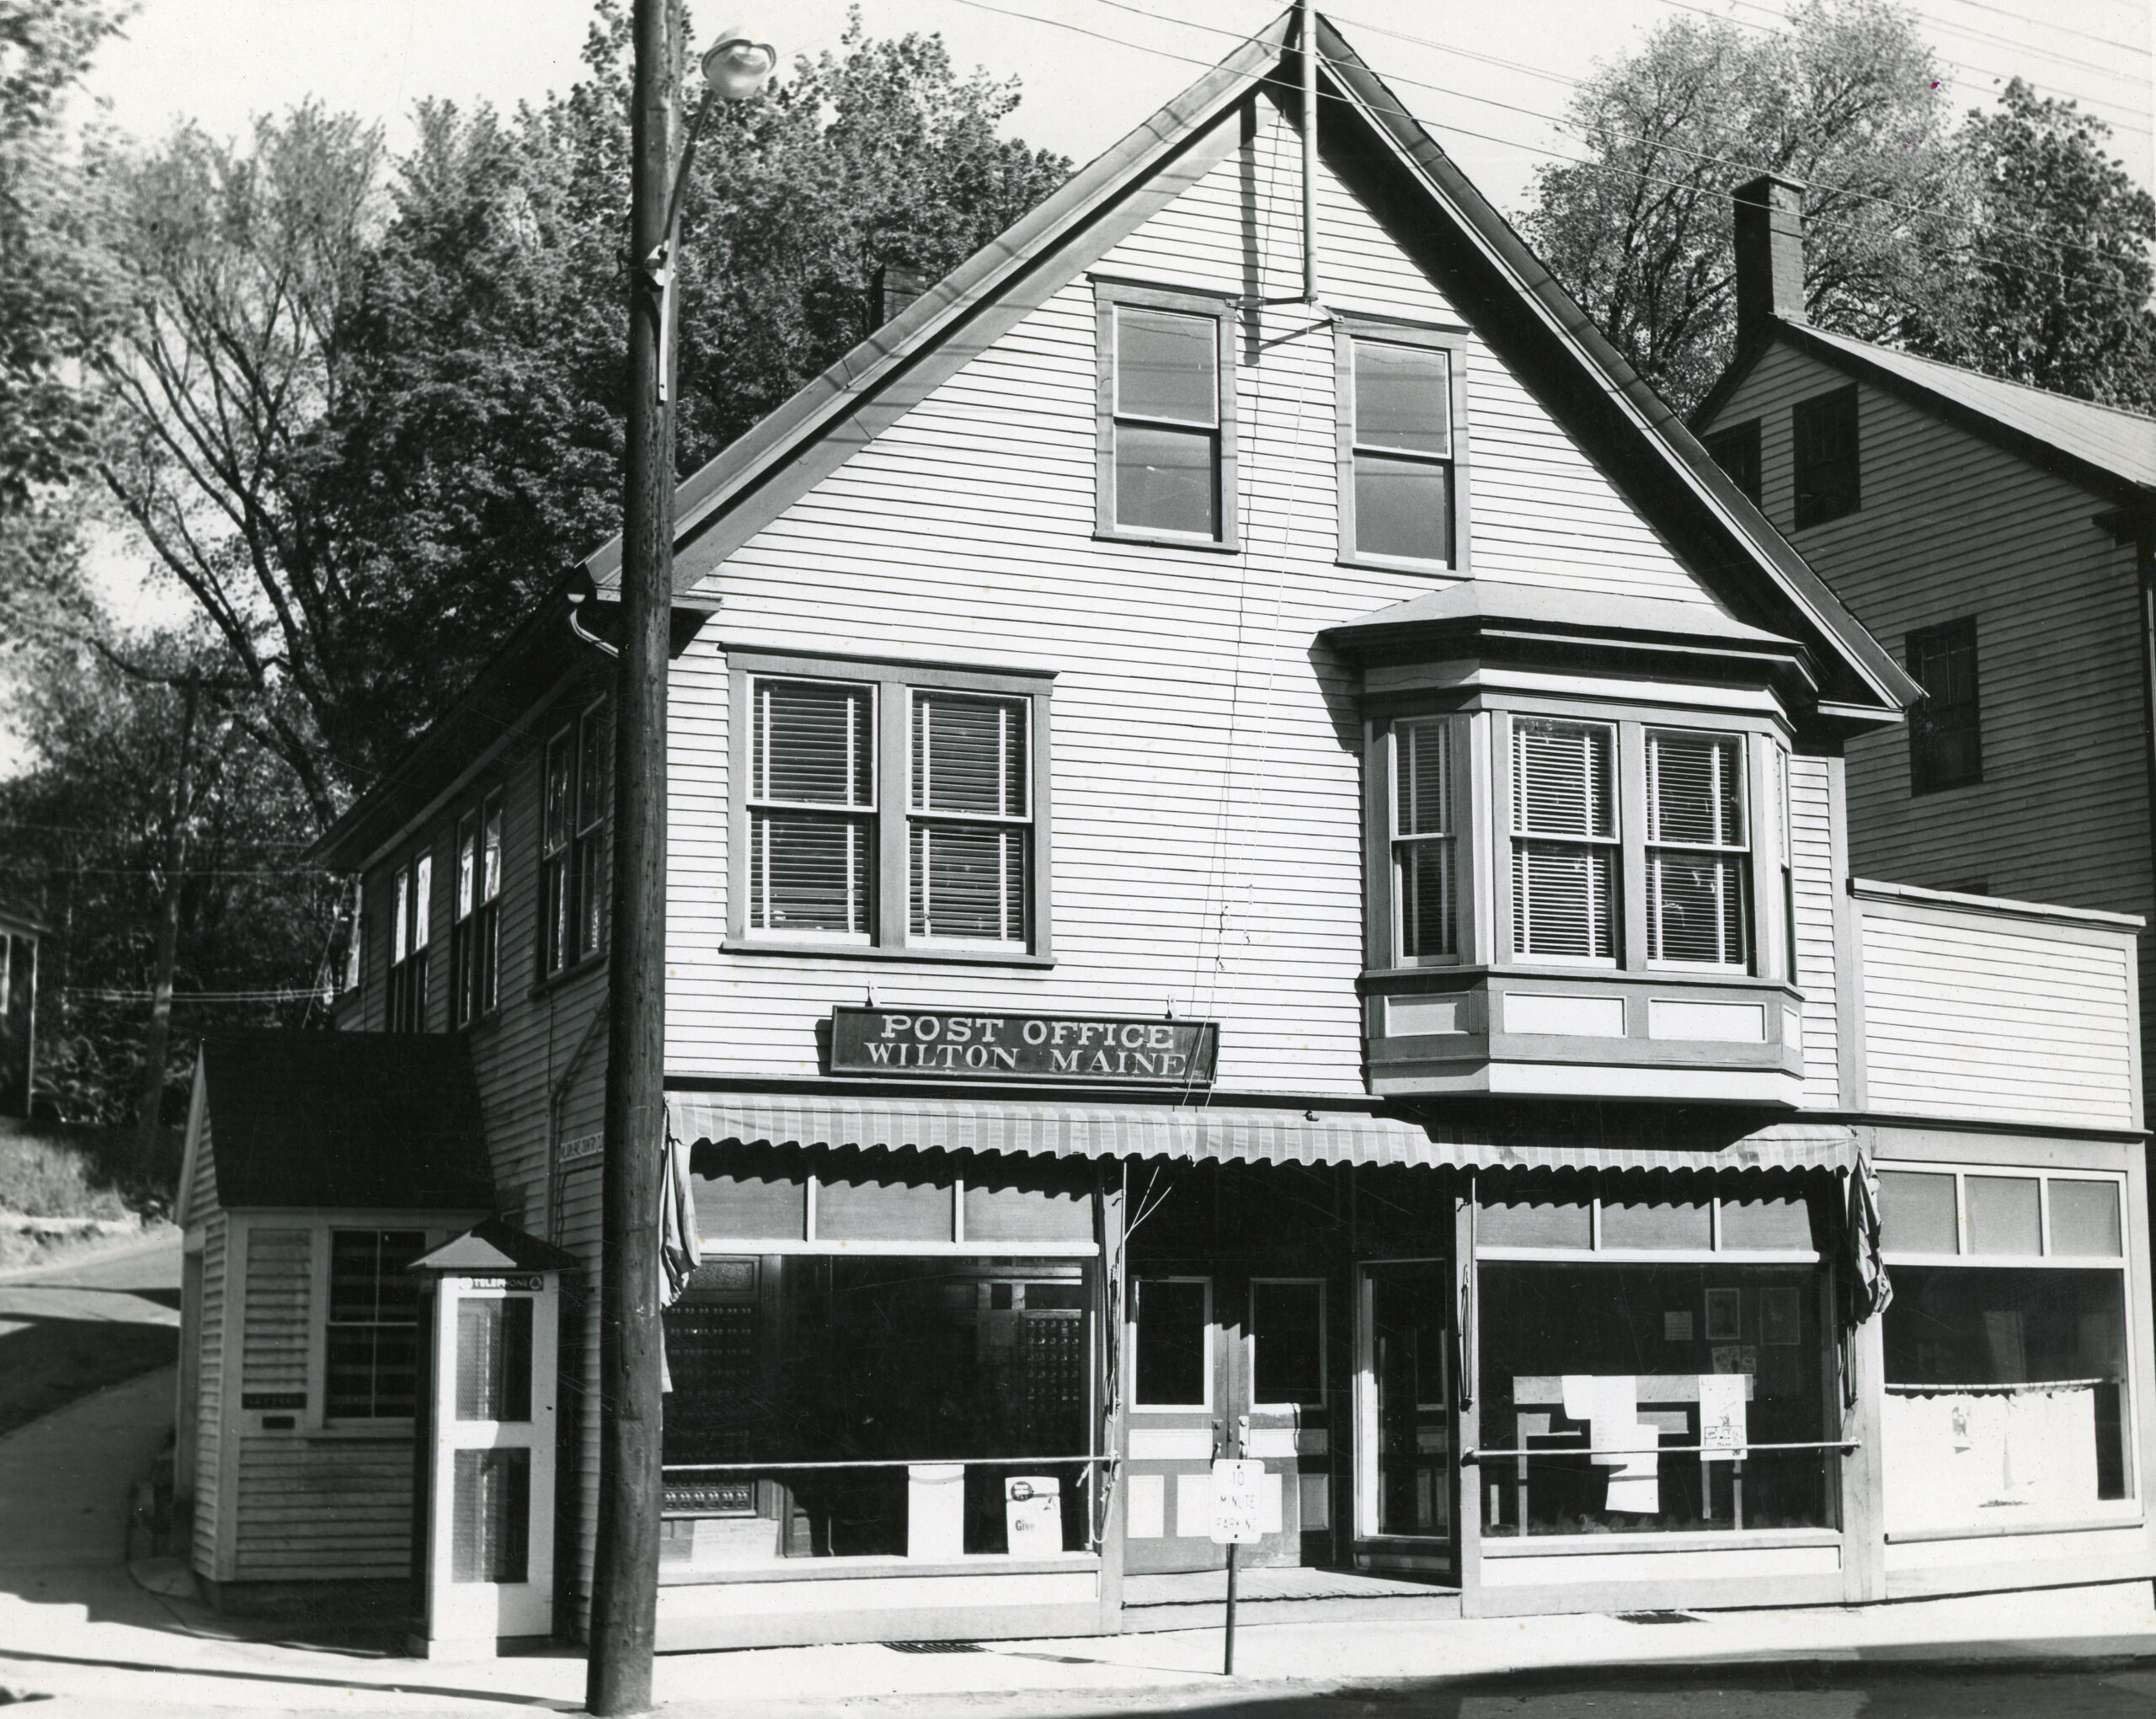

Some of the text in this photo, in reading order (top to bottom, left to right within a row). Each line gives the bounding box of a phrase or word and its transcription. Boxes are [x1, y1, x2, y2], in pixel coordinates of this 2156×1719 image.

[881, 1015, 1174, 1049] POST OFFICE
[863, 1042, 1187, 1076] WILTON MAINE
[473, 1278, 528, 1288] TELEPHONE
[1232, 1471, 1245, 1486] 10
[1220, 1494, 1254, 1509] MNUTE
[1216, 1517, 1257, 1532] PARKNG
